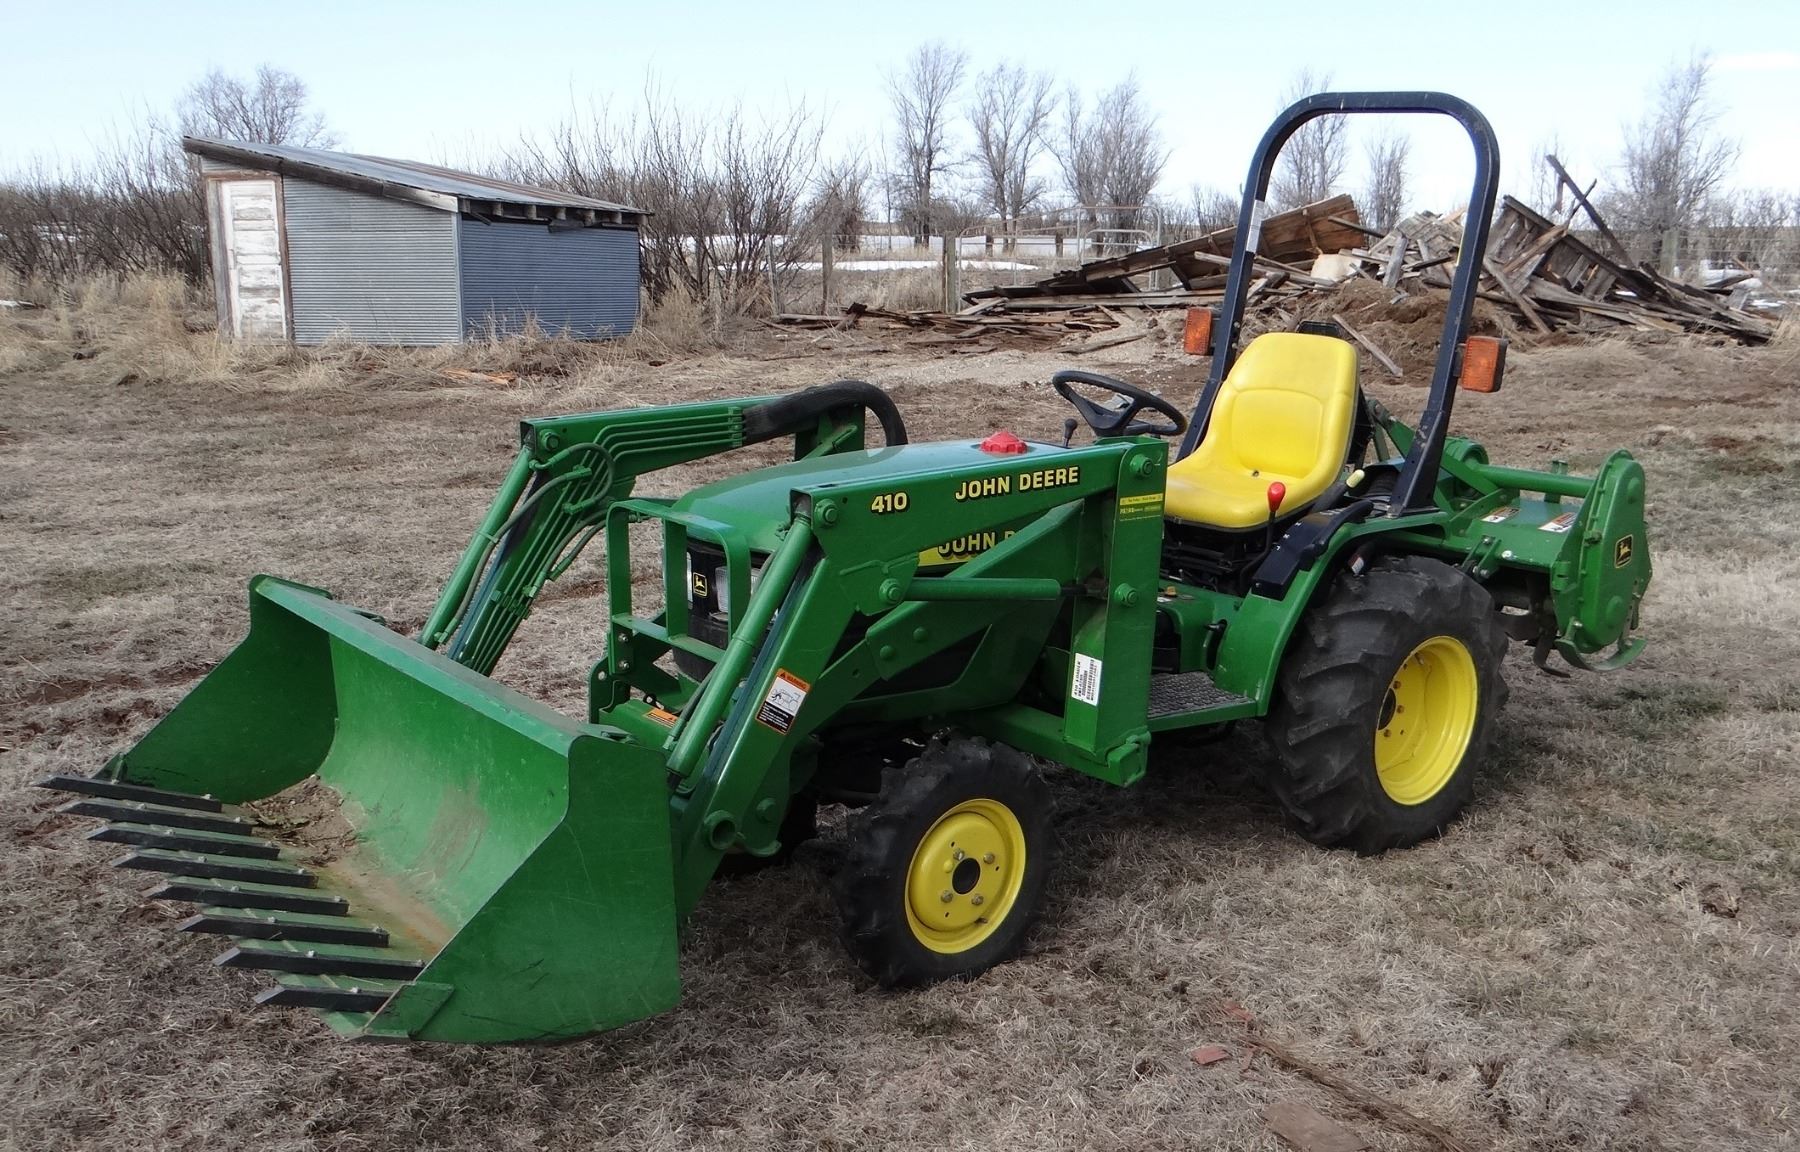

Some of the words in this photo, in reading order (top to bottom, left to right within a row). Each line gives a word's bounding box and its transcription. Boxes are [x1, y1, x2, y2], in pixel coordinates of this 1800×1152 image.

[954, 475, 1012, 502] JOHN
[1018, 465, 1081, 492] DEERE
[871, 492, 909, 515] 410
